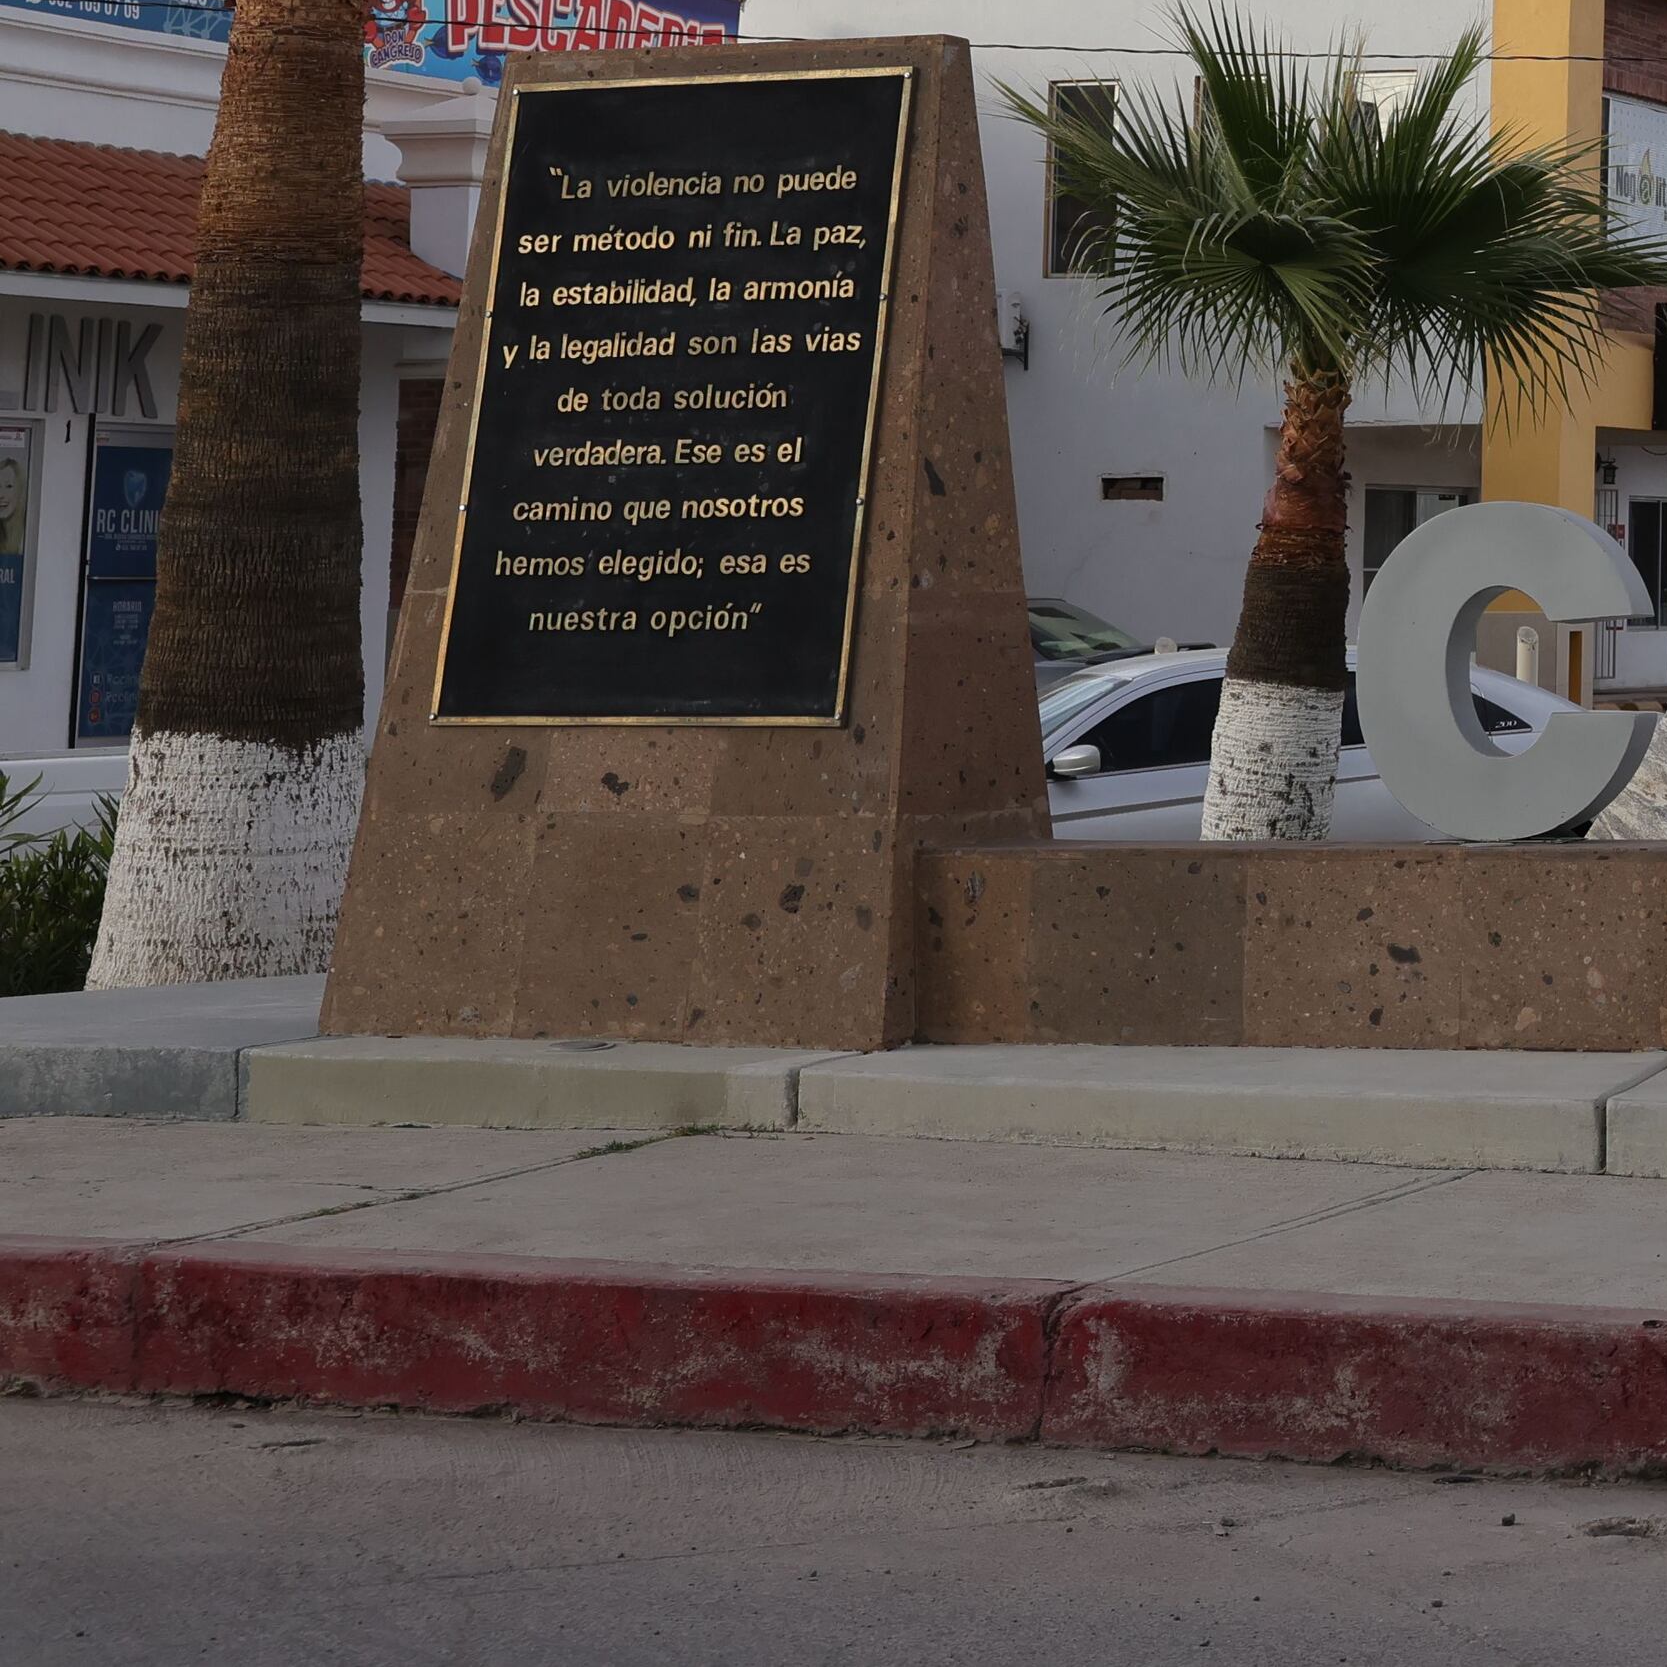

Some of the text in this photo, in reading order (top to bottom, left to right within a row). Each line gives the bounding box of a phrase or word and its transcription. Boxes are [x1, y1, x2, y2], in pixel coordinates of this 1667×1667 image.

[384, 29, 406, 46] DON
[369, 41, 424, 68] CANGREJO
[607, 171, 721, 198] violencia
[733, 174, 765, 194] no
[777, 165, 857, 198] puede
[518, 221, 866, 254] ser método ni fin. La paz,
[519, 271, 855, 308] la estabilidad, la armonía
[502, 343, 519, 369] y
[529, 334, 550, 361] la
[560, 332, 675, 366] legalidad
[687, 334, 737, 356] son
[751, 328, 792, 354] las
[557, 383, 788, 413] de toda solución
[533, 437, 804, 467] verdadera. Ese es el
[97, 508, 158, 534] RC CLINI
[513, 494, 804, 526] camino que nosotros
[495, 548, 811, 582] hemos elegido; esa es
[528, 607, 637, 632] nuestra
